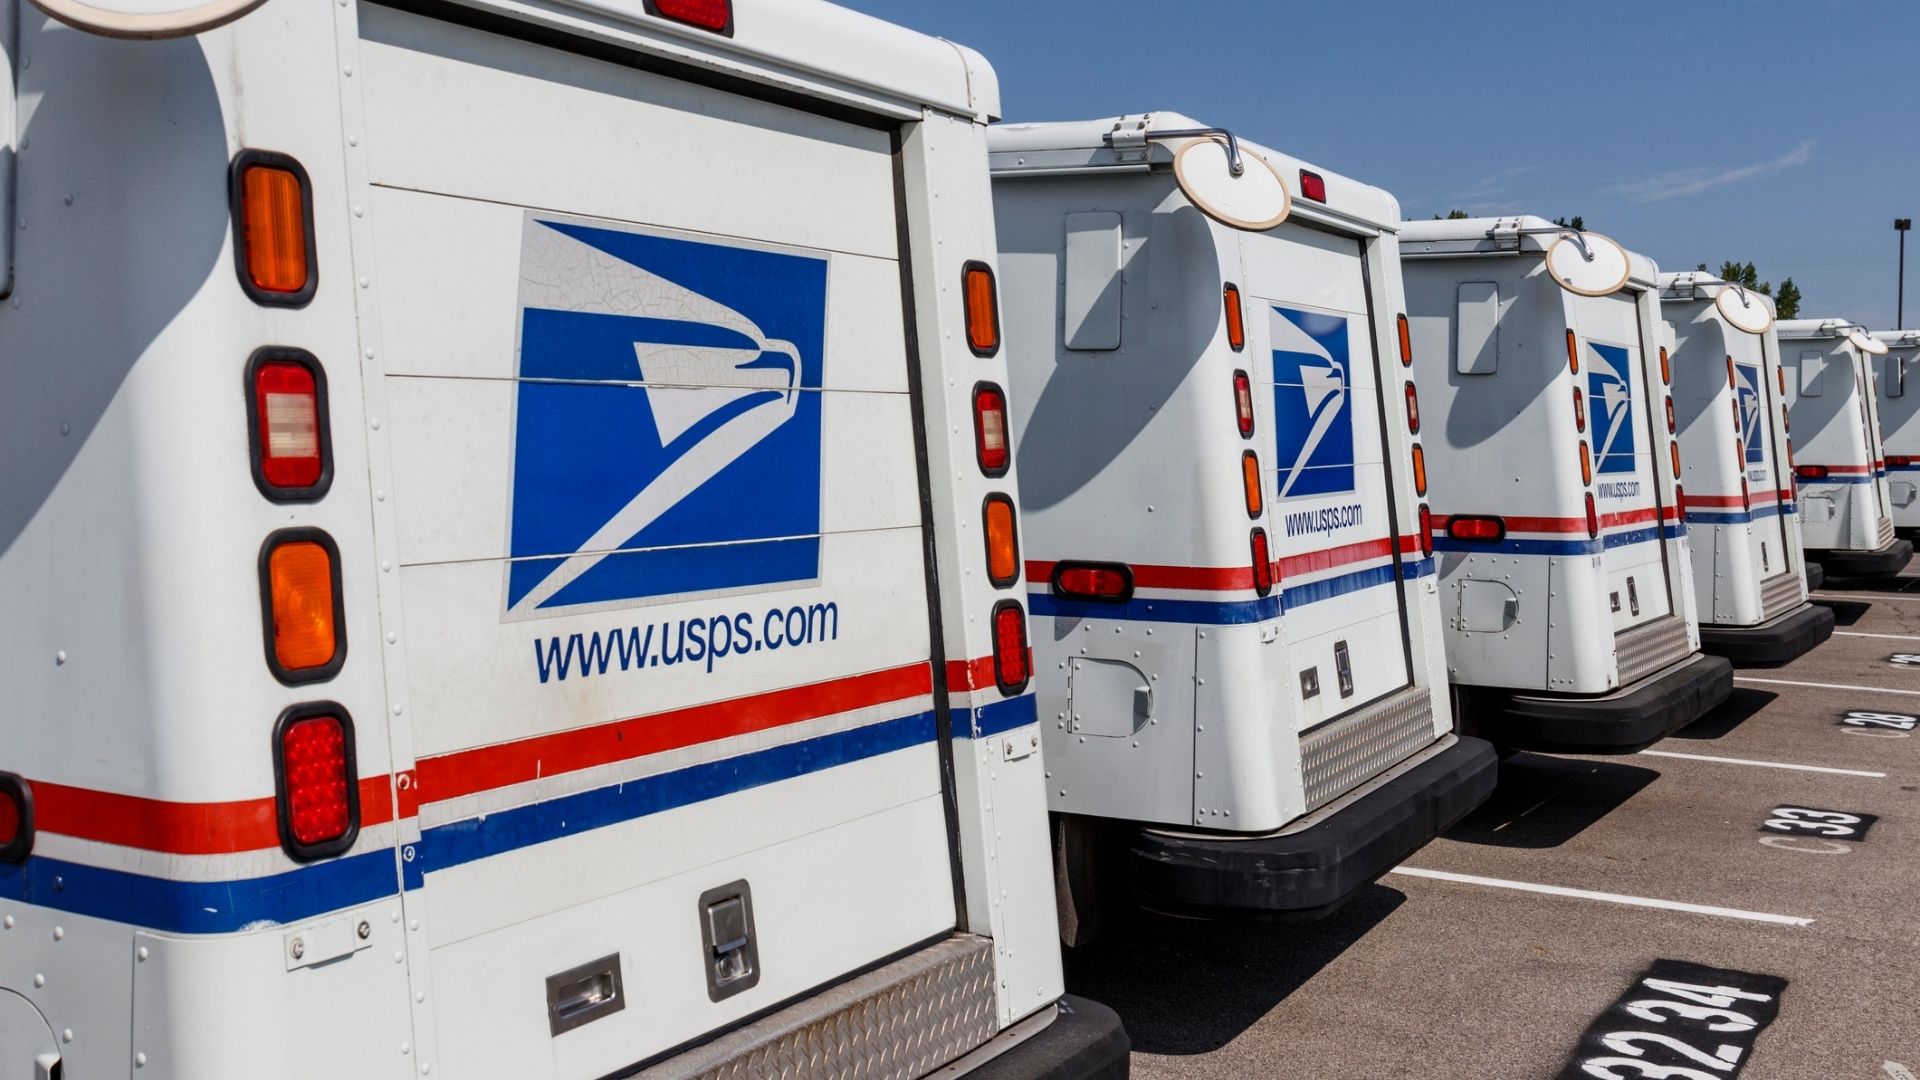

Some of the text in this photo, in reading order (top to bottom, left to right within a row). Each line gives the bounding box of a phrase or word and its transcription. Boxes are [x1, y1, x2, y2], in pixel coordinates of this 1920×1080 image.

[1285, 504, 1362, 537] www.usps.com
[534, 601, 838, 683] www.usps.com
[1764, 808, 1861, 835] 33
